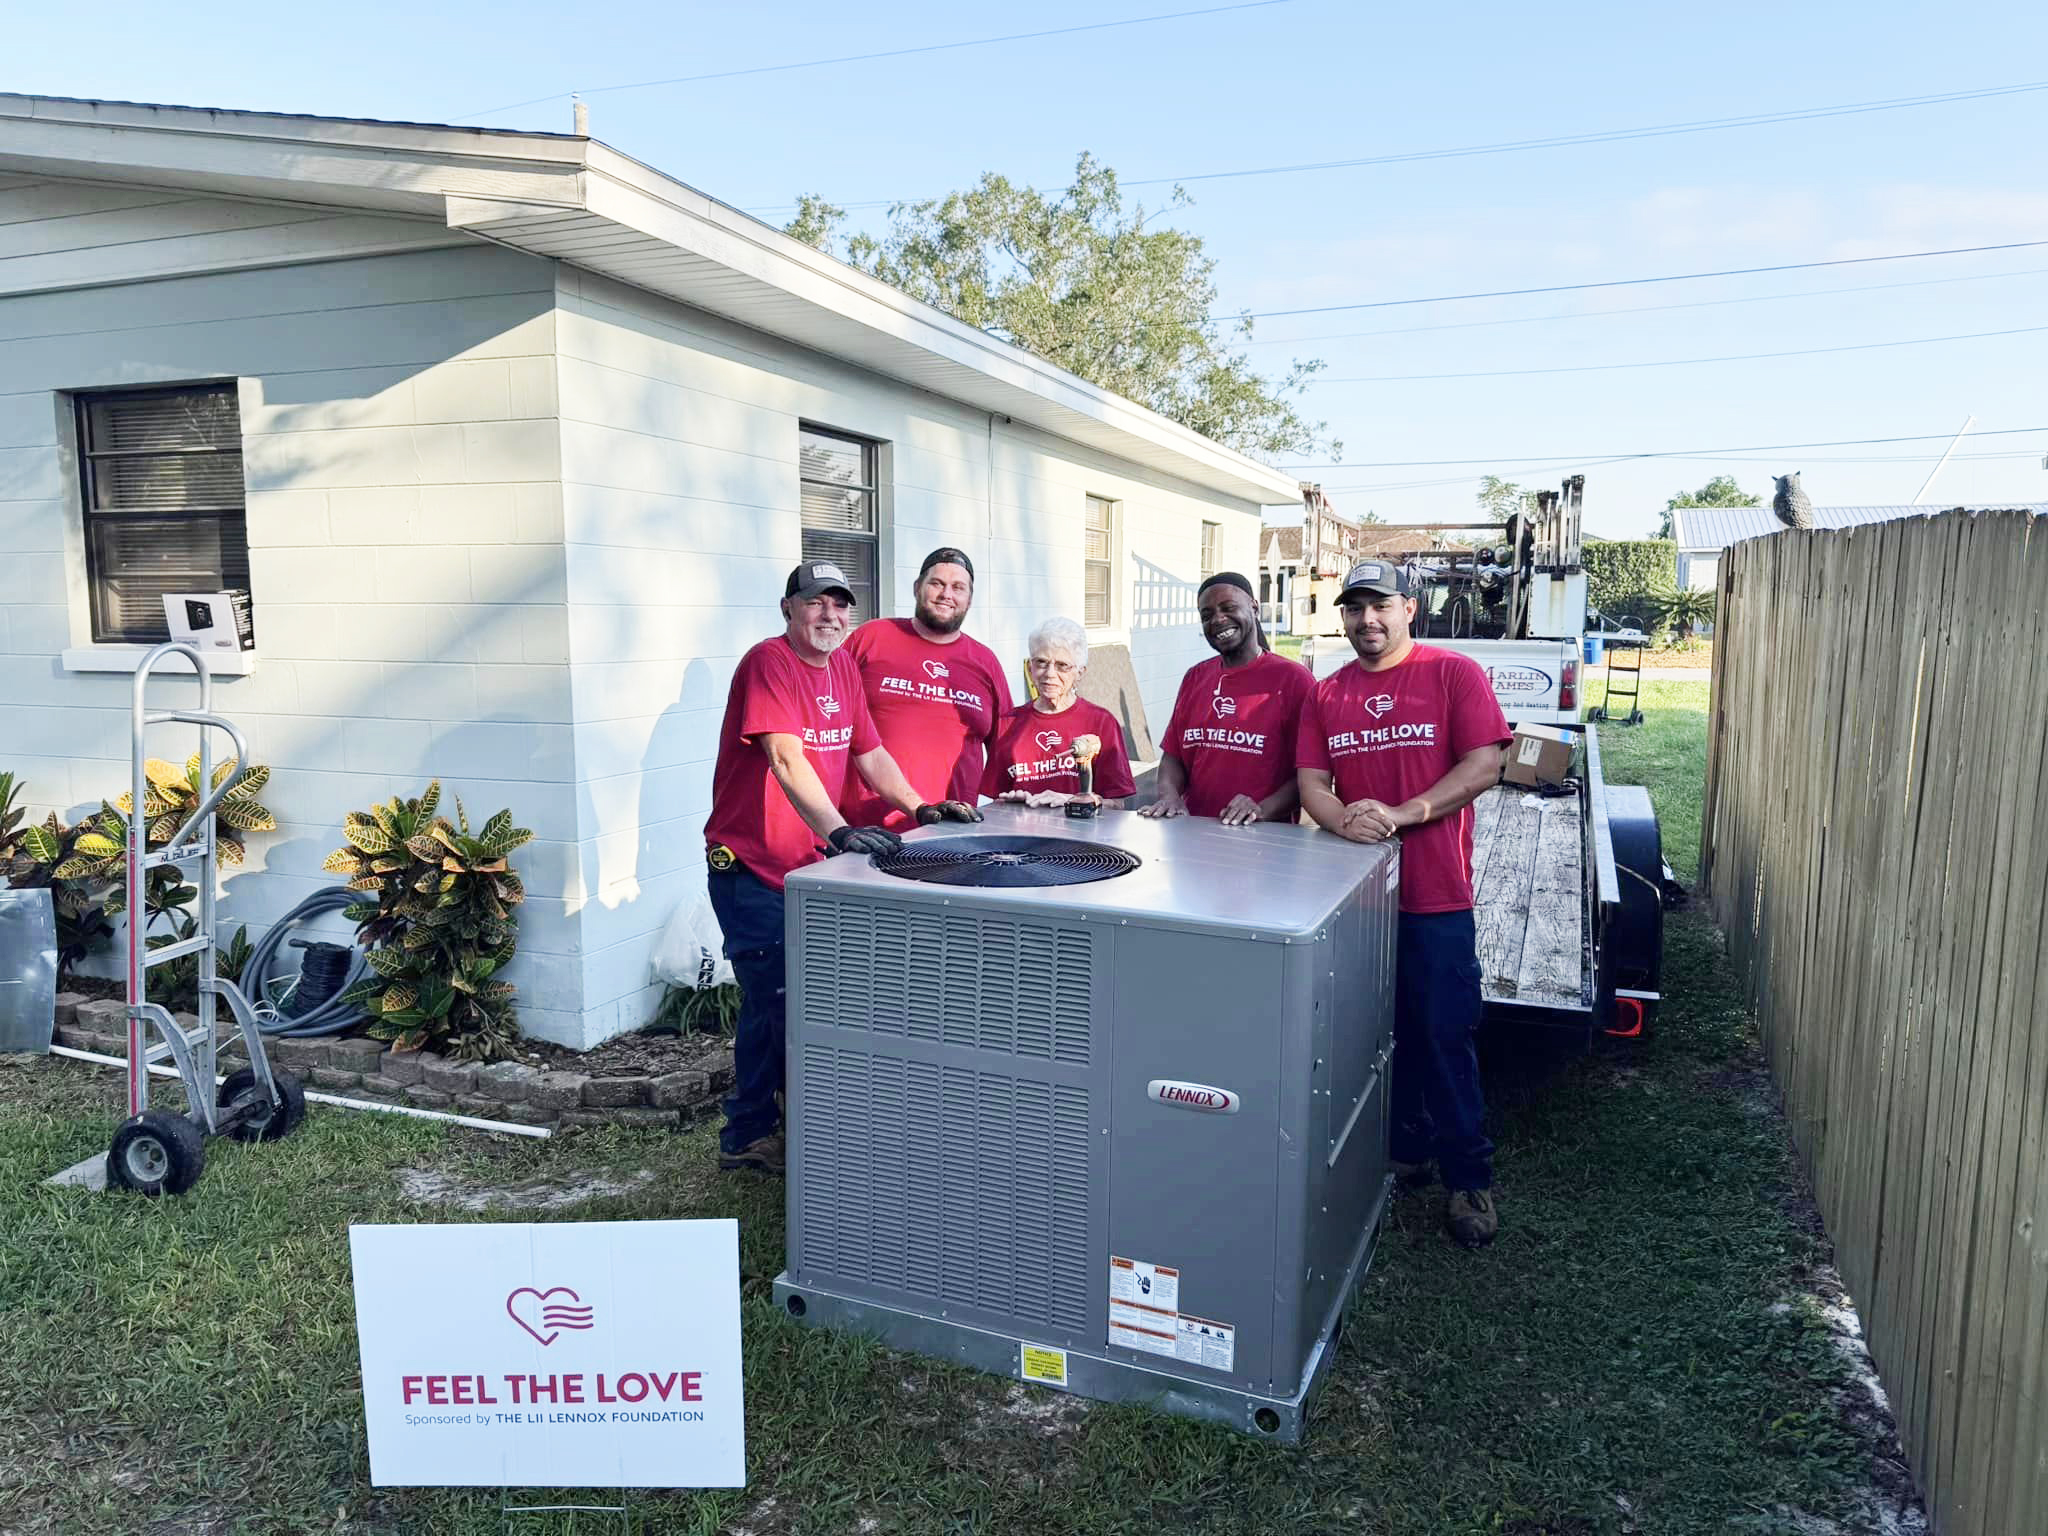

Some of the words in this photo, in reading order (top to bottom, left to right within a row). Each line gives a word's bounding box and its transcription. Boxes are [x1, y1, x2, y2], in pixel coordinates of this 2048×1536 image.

[881, 677, 914, 691] FEEL
[918, 682, 946, 697] THE
[949, 688, 982, 706] LOVE
[819, 728, 840, 743] THE
[1227, 730, 1264, 747] LOVE
[1328, 732, 1359, 751] FEEL
[1360, 728, 1390, 744] THE
[1392, 724, 1434, 739] LOVE
[1033, 759, 1056, 773] THE
[1059, 756, 1077, 768] LO
[1159, 1085, 1216, 1106] LENNOX
[402, 1375, 497, 1405] FEEL
[504, 1374, 585, 1404] THE
[597, 1372, 703, 1403] LOVE
[405, 1413, 471, 1426] Sponsored
[476, 1413, 491, 1426] by
[495, 1413, 523, 1424] THE
[549, 1412, 607, 1423] LENNOX
[612, 1411, 704, 1422] FOUNDATION
